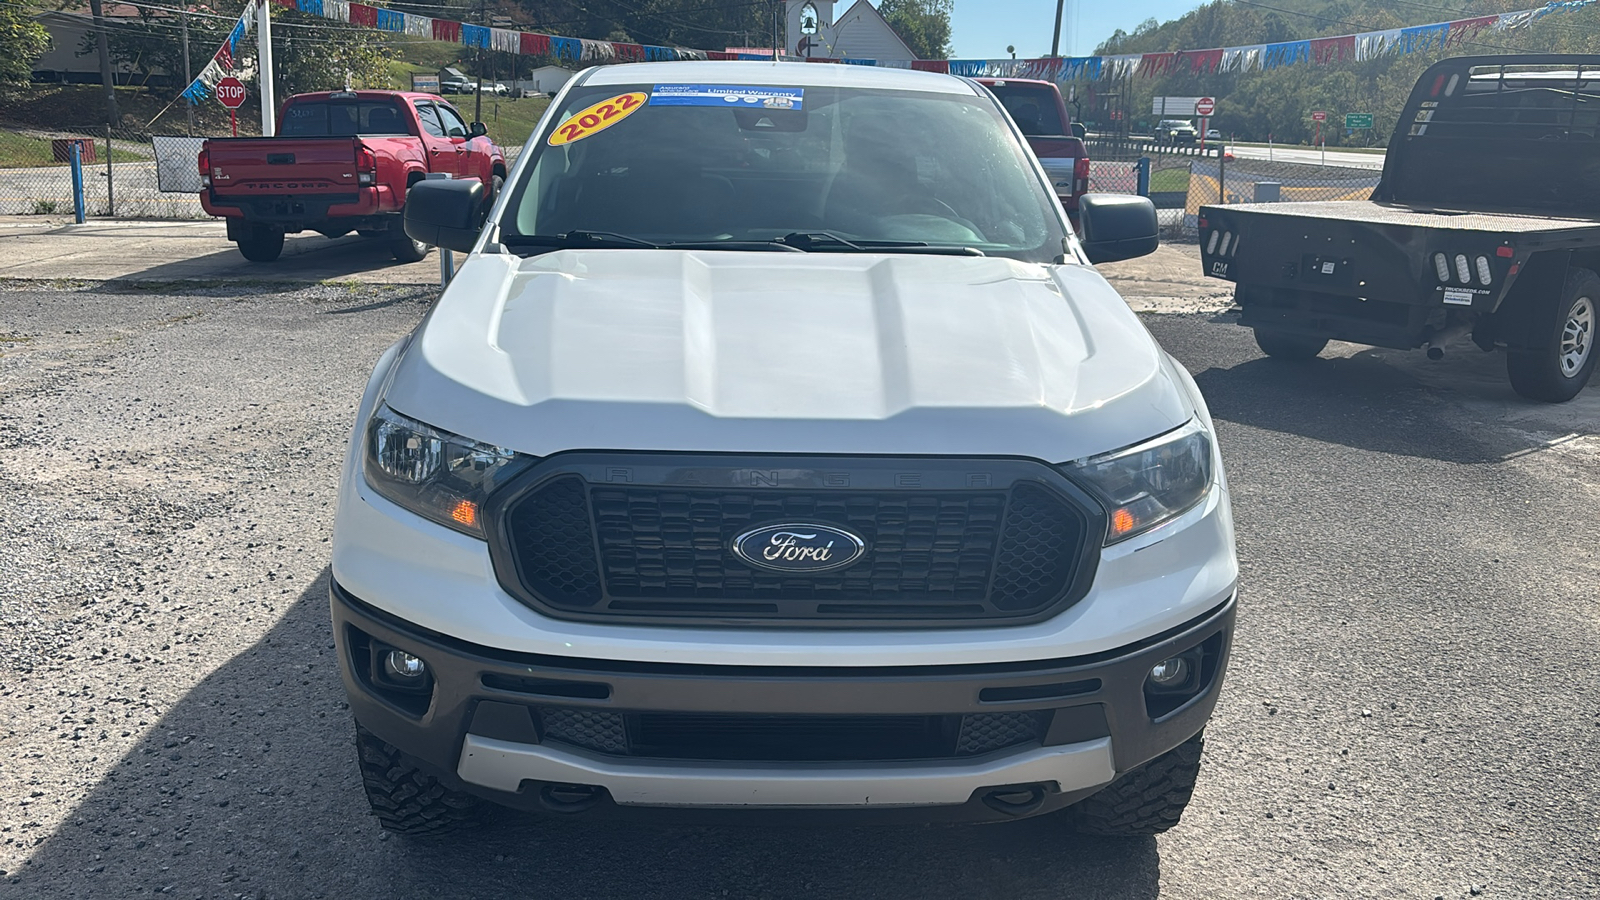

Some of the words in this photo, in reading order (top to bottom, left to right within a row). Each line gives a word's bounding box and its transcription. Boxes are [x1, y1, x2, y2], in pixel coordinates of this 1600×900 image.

[217, 86, 244, 98] STOP
[559, 94, 641, 142] 2022
[606, 466, 993, 489] RANGER
[763, 531, 834, 561] Ford
